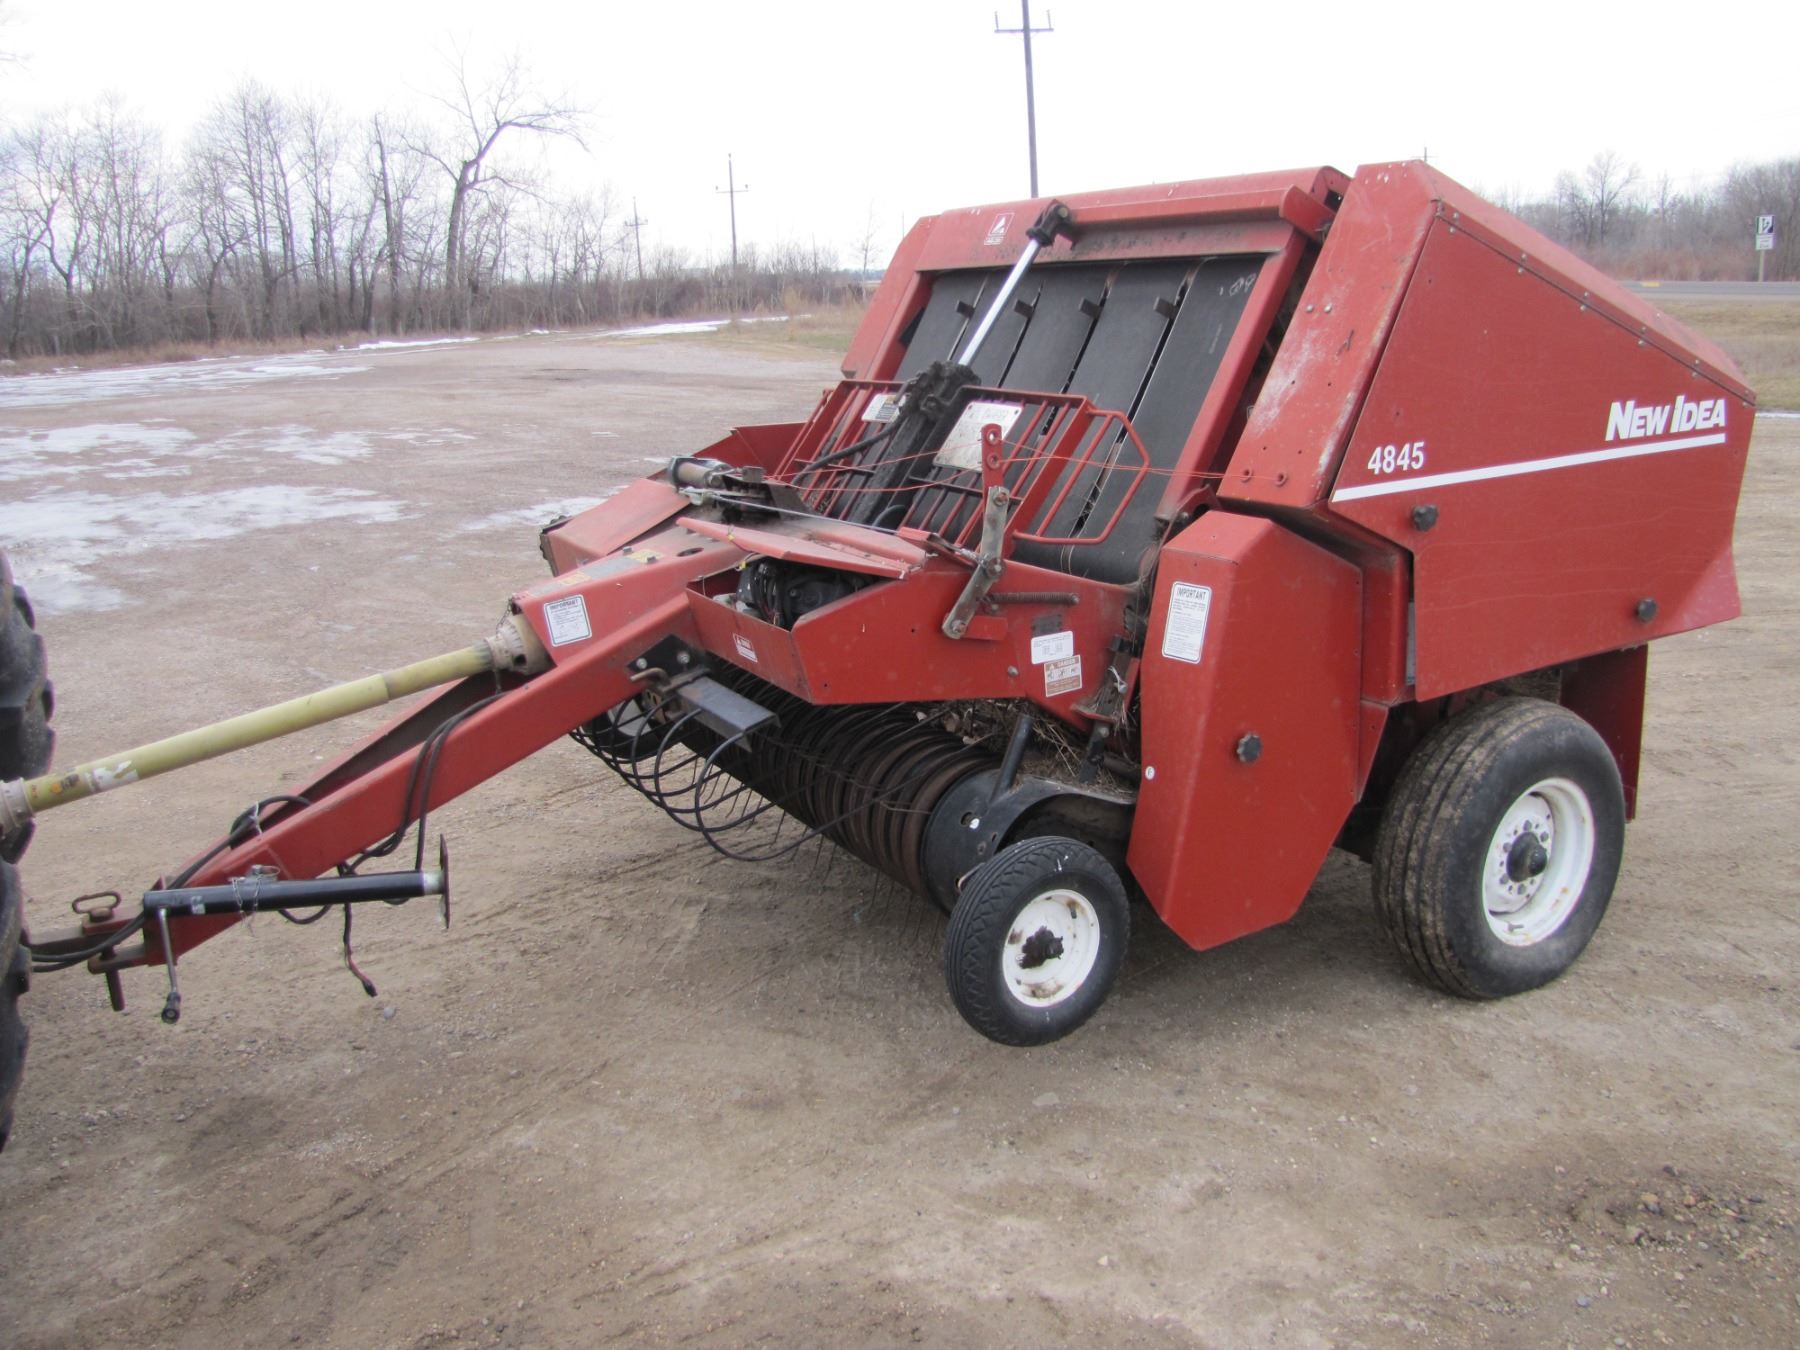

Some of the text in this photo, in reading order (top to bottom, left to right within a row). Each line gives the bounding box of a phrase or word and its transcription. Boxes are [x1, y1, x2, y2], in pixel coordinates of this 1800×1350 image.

[1604, 394, 1725, 441] NEW IDEA
[1367, 441, 1425, 475] 4845
[1176, 586, 1207, 600] IMPORTANT
